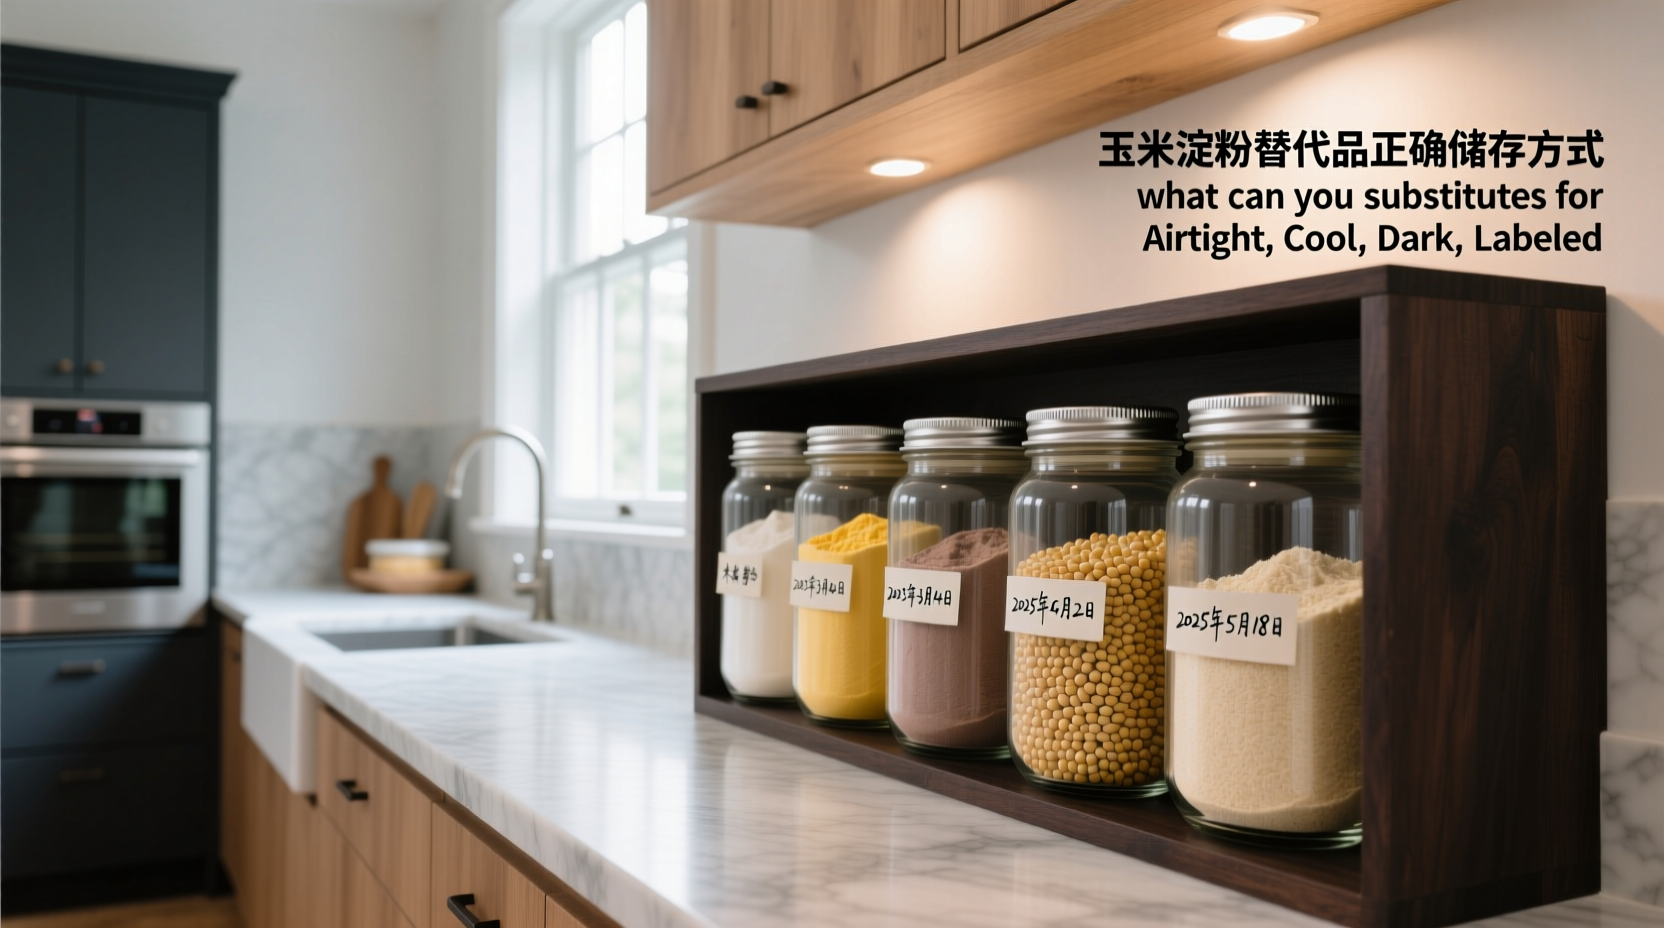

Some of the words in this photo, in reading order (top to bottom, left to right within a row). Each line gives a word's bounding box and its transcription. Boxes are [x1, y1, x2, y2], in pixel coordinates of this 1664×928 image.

[1011, 590, 1094, 626] 2025年4月2日
[1176, 605, 1282, 642] 2025年5月18日
